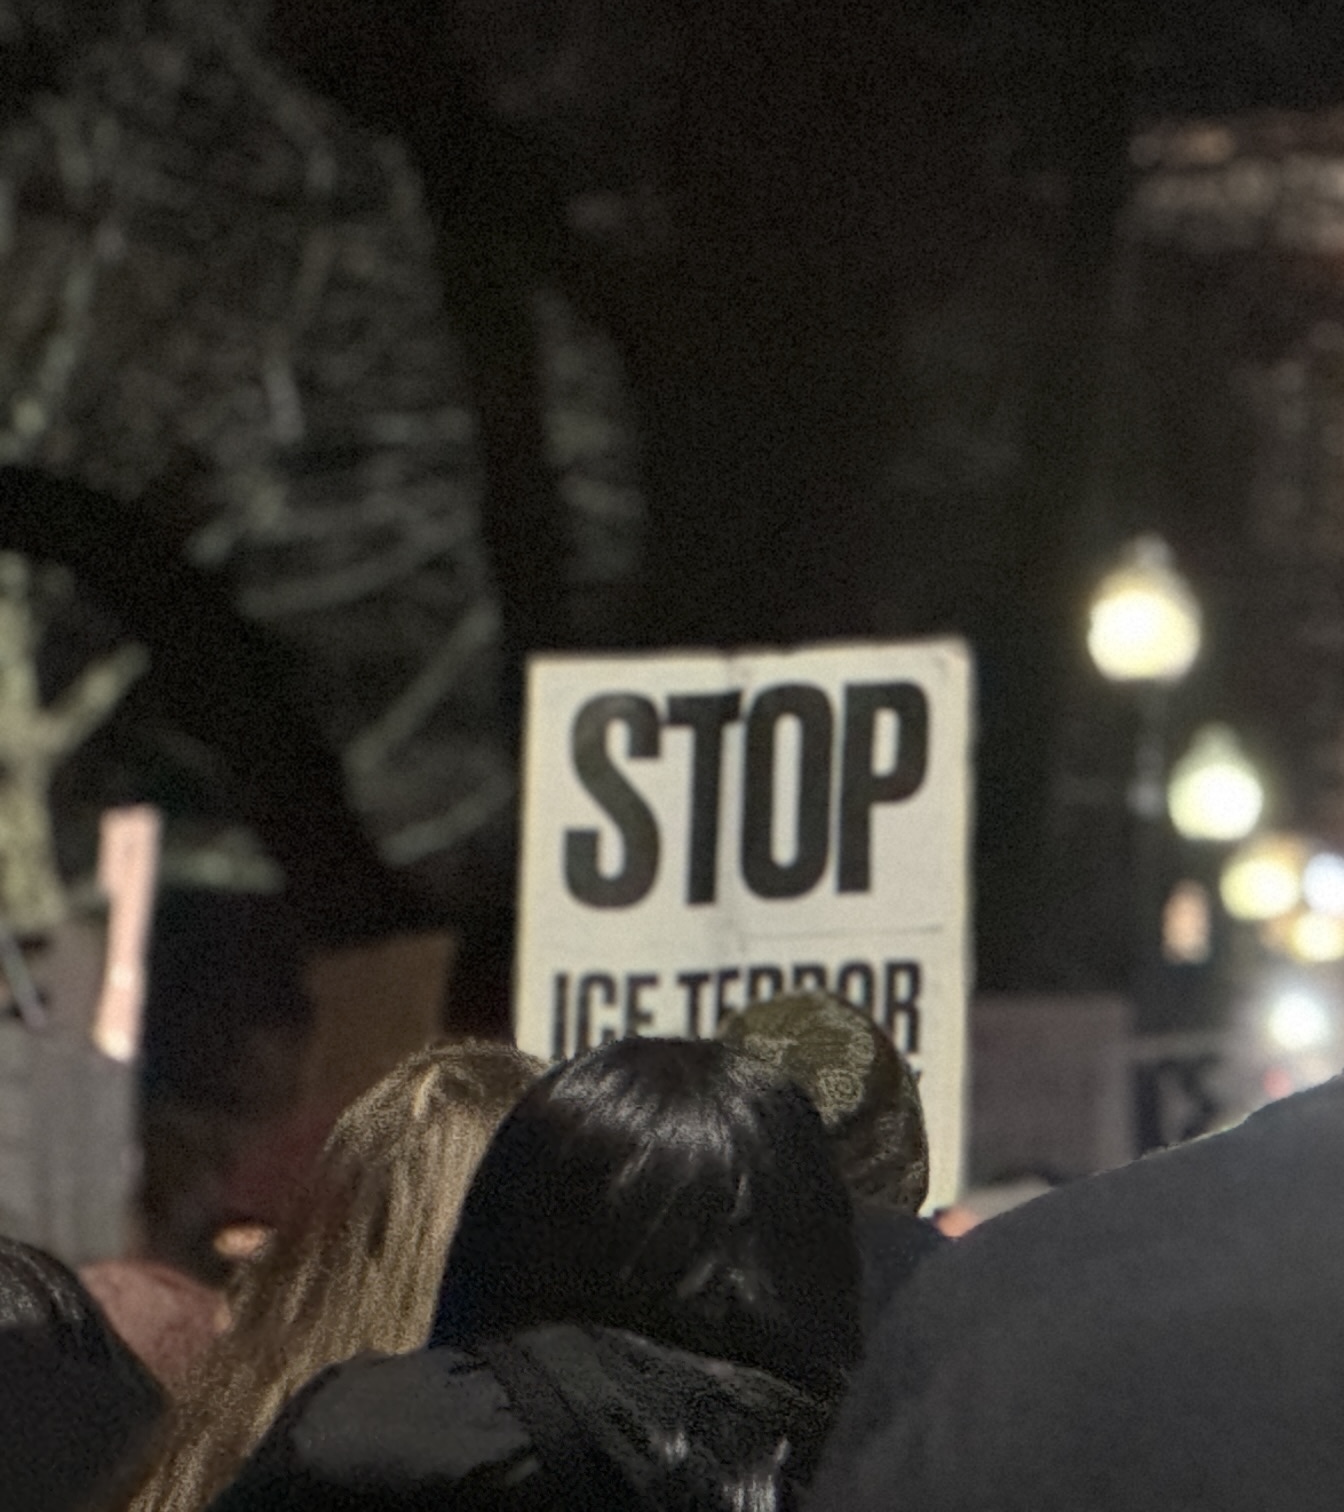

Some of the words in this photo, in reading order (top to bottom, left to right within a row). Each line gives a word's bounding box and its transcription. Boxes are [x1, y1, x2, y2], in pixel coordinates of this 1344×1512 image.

[562, 680, 930, 910] STOP
[550, 970, 660, 1065] ICE
[676, 959, 922, 1055] TER
